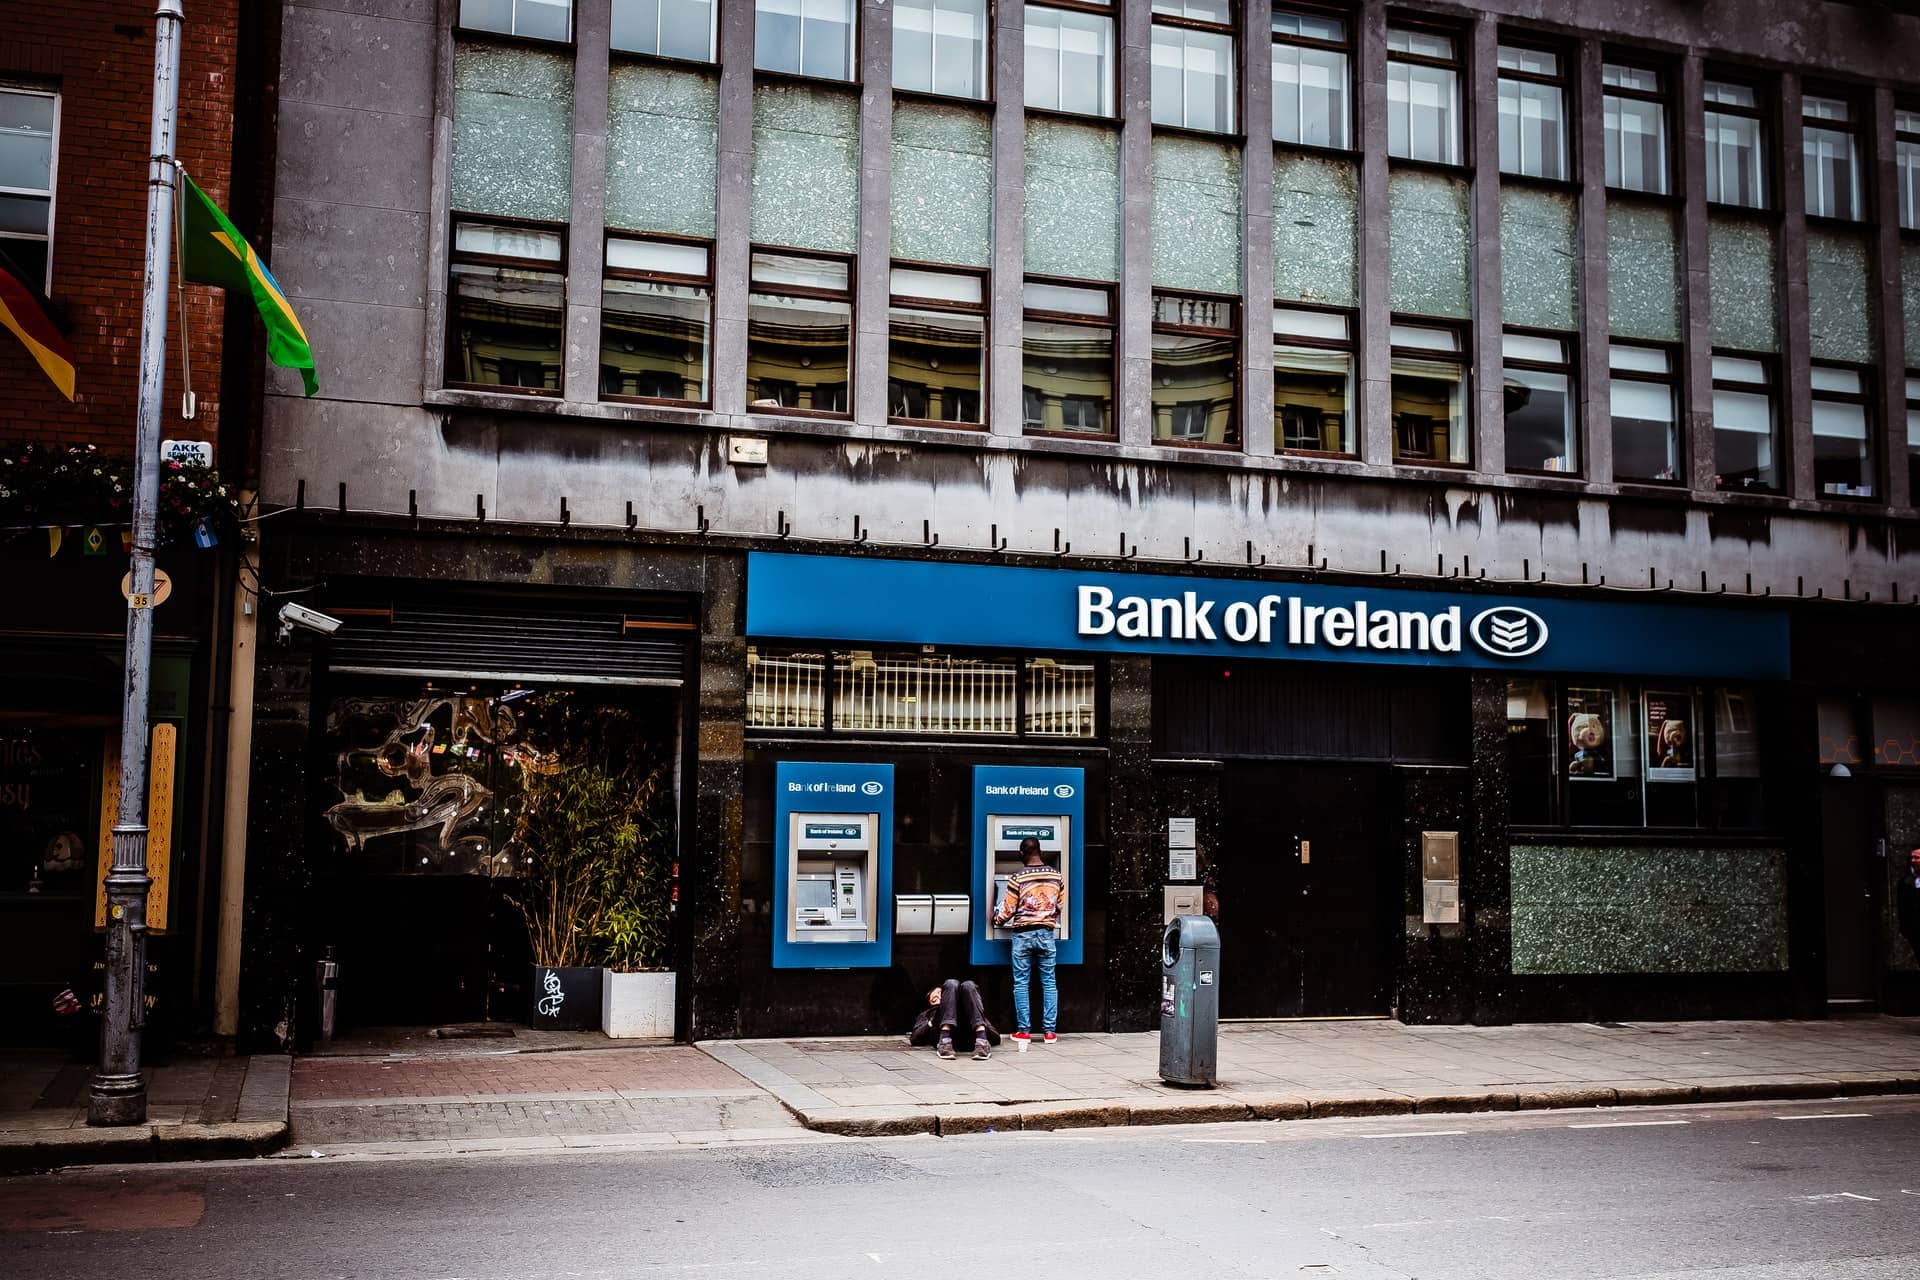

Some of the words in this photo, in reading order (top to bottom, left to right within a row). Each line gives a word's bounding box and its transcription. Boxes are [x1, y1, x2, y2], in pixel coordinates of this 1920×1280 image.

[172, 444, 200, 452] AKK
[134, 597, 148, 606] 35
[1078, 585, 1216, 640] Bank
[1224, 594, 1281, 642] of
[1289, 597, 1465, 651] Ireland
[788, 782, 813, 792] Bank
[813, 782, 824, 792] of
[824, 782, 856, 793] Ireland
[985, 785, 1008, 795] Bank
[1008, 786, 1018, 795] of
[1019, 786, 1049, 796] Ireland
